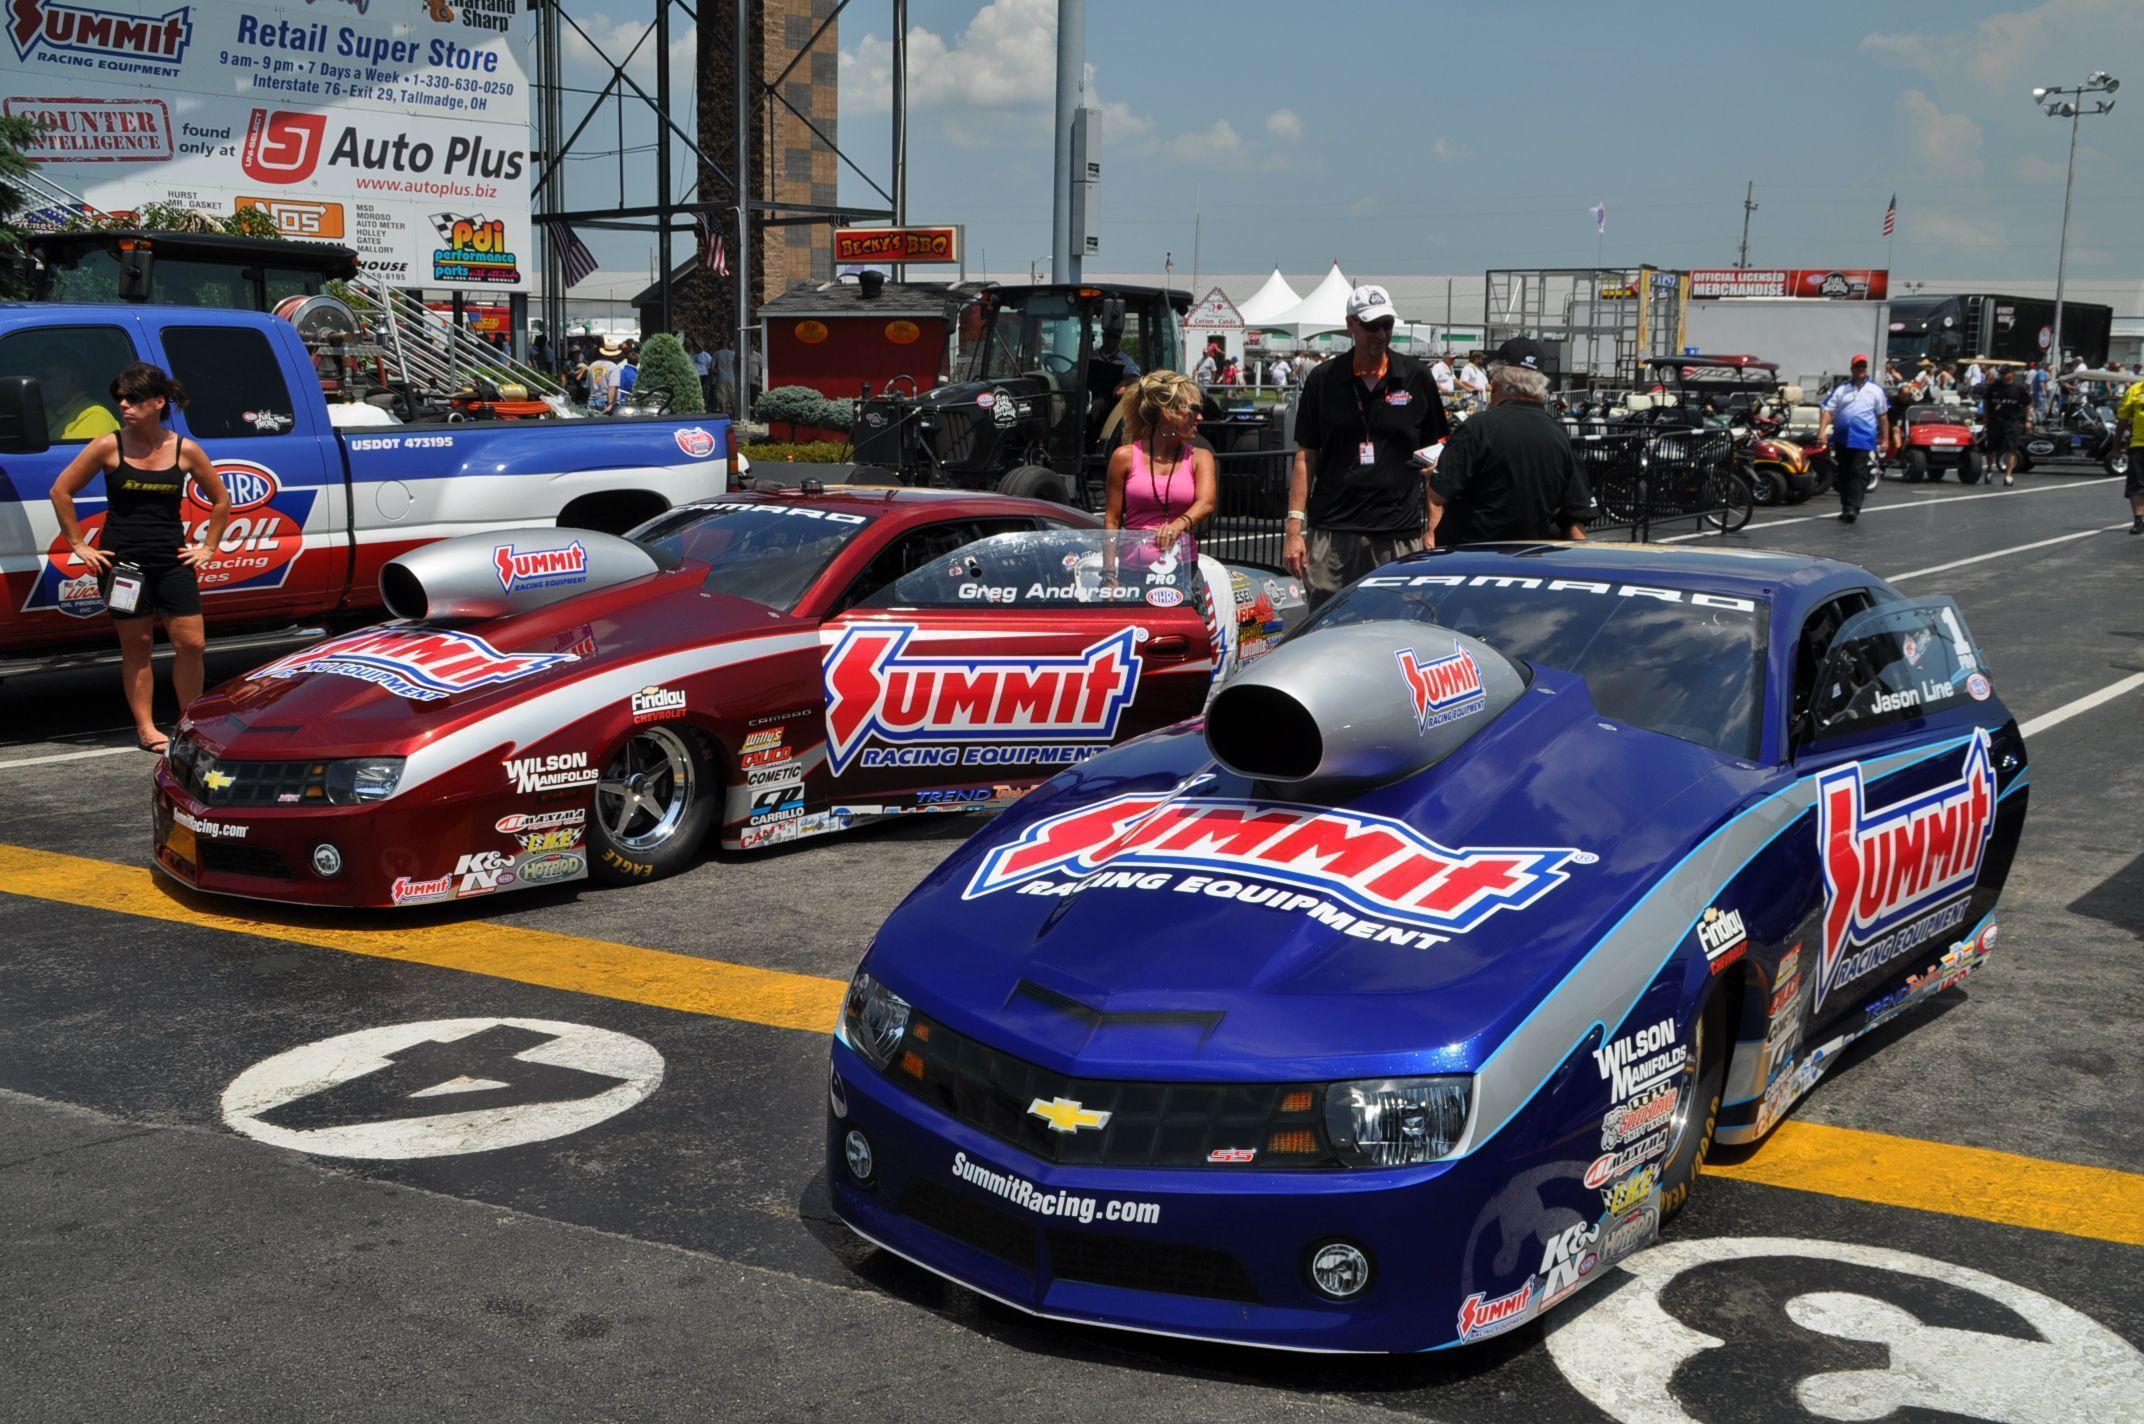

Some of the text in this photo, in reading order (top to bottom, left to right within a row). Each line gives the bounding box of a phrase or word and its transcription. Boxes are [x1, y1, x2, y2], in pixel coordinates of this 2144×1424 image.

[463, 9, 509, 32] Sharp
[238, 14, 498, 73] Retail Super Store
[37, 52, 181, 77] RACING EQUIPMENT
[220, 51, 228, 64] 9
[273, 59, 294, 73] pm
[308, 61, 315, 73] 7
[320, 62, 352, 80] Days
[353, 69, 362, 80] a
[365, 67, 400, 84] Week
[413, 74, 514, 96] 1-330-630-0250
[253, 73, 319, 94] Interstate
[400, 89, 468, 111] Tallmadge,
[470, 96, 488, 111] OH
[21, 110, 158, 133] COUNTER
[182, 123, 231, 139] found
[179, 143, 236, 158] only at
[328, 126, 525, 181] Auto Plus
[167, 190, 198, 199] HURST
[356, 177, 498, 199] www.autoplus.biz
[189, 200, 223, 209] GASKET
[356, 203, 374, 212] MSD
[356, 212, 392, 221] MOROSO
[356, 220, 406, 230] AUTO METER
[356, 229, 387, 238] HOLLEY
[356, 237, 382, 246] GATES
[356, 245, 394, 254] MALLORY
[906, 234, 948, 256] BBQ
[434, 248, 516, 263] performance
[434, 264, 469, 278] parts
[1693, 272, 1785, 283] OFFICIAL LICENSED
[1693, 283, 1785, 296] MERCHANDISE
[351, 436, 454, 451] USDOT 473195
[210, 473, 265, 505] HRA
[197, 572, 230, 584] ies
[514, 576, 588, 592] RACING EQUIPMENT
[1145, 573, 1177, 585] PRO
[64, 586, 101, 600] LUCA
[958, 582, 1141, 604] Greg Anderson
[1150, 590, 1180, 605] NHRA
[1356, 574, 1757, 613] CAMARO
[631, 688, 687, 711] Findlay
[1871, 678, 1955, 715] Jason Line
[633, 708, 688, 724] CHEVROLET
[1427, 711, 1453, 729] RACING
[502, 751, 588, 780] WILSON
[861, 746, 958, 767] RACING
[517, 768, 600, 794] MANIFOLDS
[748, 766, 802, 786] COMETIC
[916, 789, 992, 804] TREND
[750, 807, 805, 827] CARRILLO
[1016, 872, 1451, 950] RACING EQUIPMENT
[1696, 908, 1747, 953] Findlay
[1834, 935, 1896, 990] RACING
[1893, 896, 1972, 958] EQUIPMENT
[1593, 1017, 1677, 1080] WILSON
[1611, 1044, 1688, 1105] MANIFOLDS
[952, 1152, 1161, 1224] SummitRacing.com
